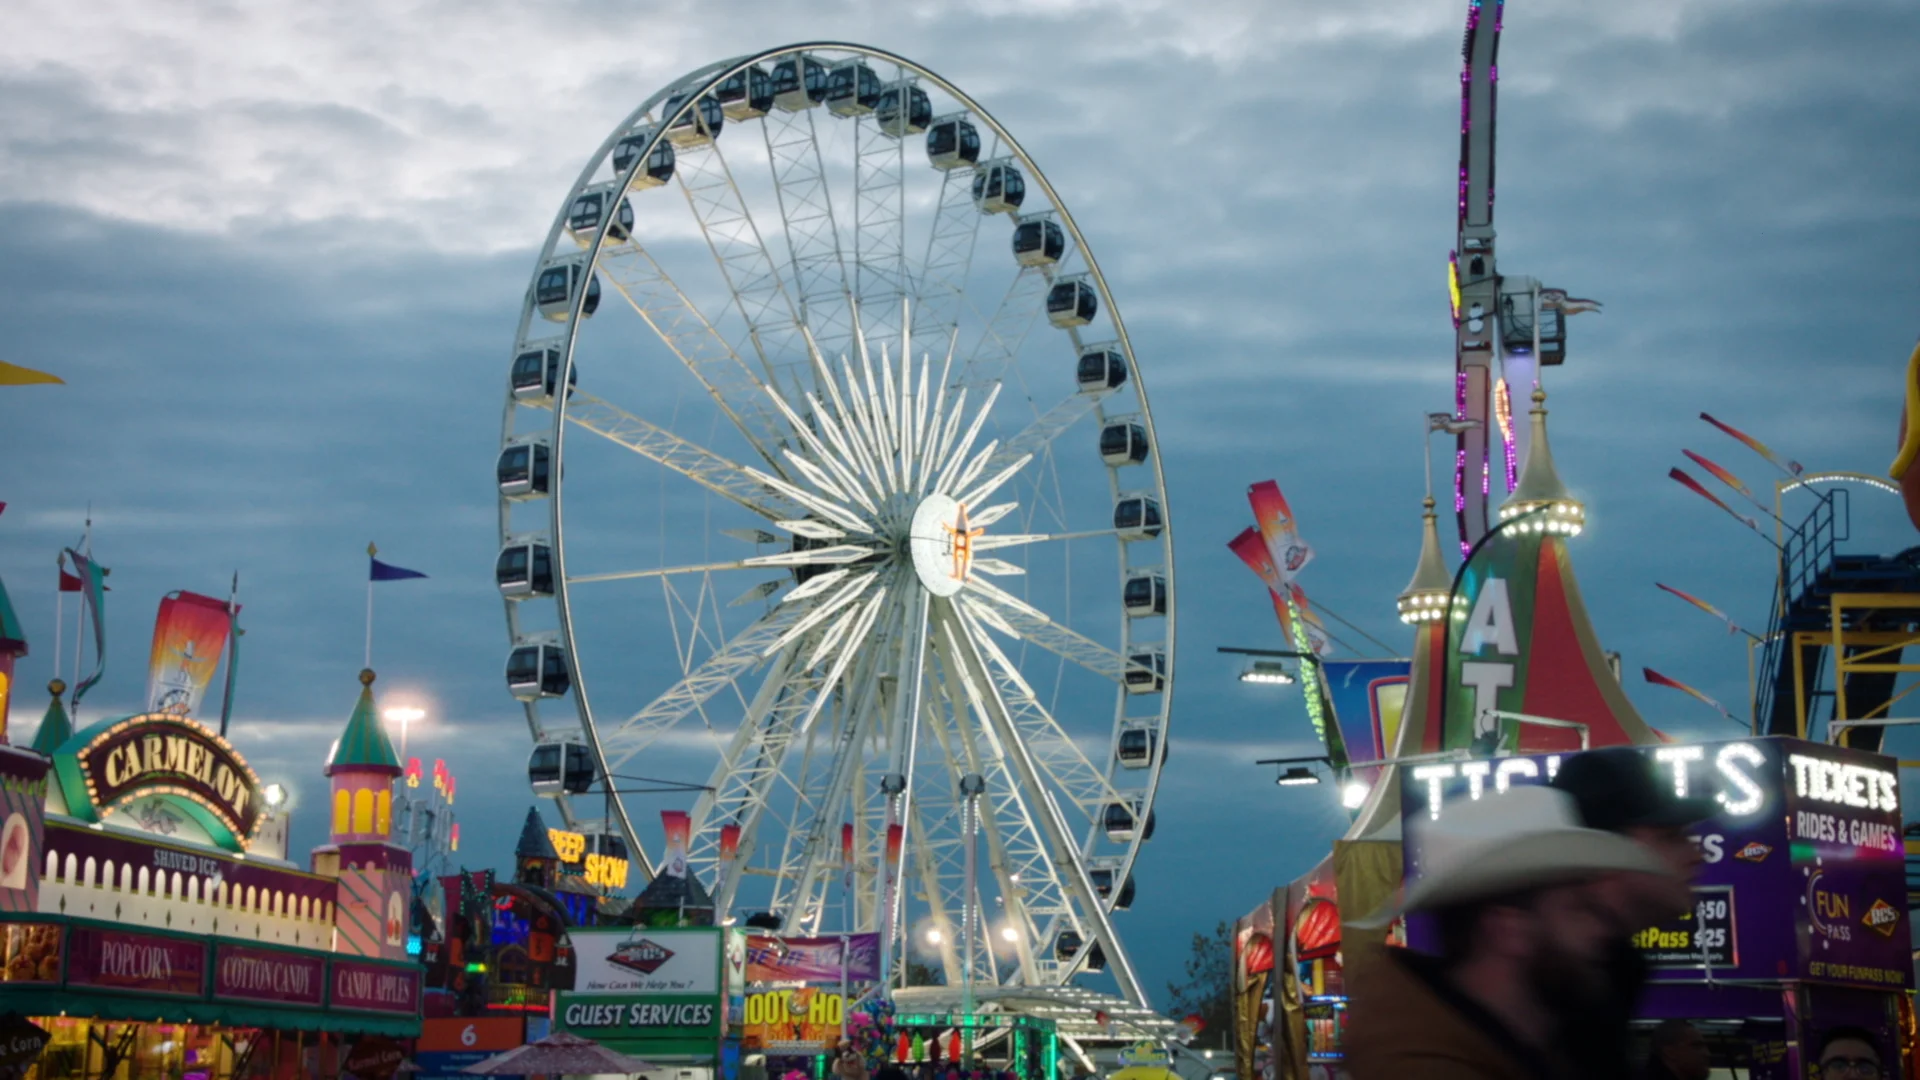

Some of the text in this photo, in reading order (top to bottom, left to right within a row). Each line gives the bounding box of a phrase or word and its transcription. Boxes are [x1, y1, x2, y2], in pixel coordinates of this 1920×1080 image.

[1459, 577, 1519, 750] AT
[105, 735, 250, 819] CARMELOT
[1789, 753, 1897, 812] TICKETS
[1797, 811, 1896, 851] RIDES & GAMES
[154, 849, 218, 876] SHAVED ICE
[584, 853, 629, 889] SHOW
[1696, 900, 1726, 919] $50
[1816, 890, 1849, 919] FUN
[1871, 907, 1896, 925] RCS
[1631, 927, 1726, 948] stPass $25
[1827, 924, 1851, 941] PASS
[101, 940, 173, 979] POPCORN
[1809, 961, 1826, 976] GET
[1826, 963, 1847, 978] YOUR
[1849, 965, 1883, 982] FUNPASS
[223, 956, 312, 995] COTTON CANDY
[338, 970, 410, 1003] CANDY APPLES
[586, 981, 607, 990] How
[609, 981, 628, 989] Can
[630, 981, 643, 989] We
[645, 980, 667, 990] Help
[670, 981, 685, 989] You
[565, 1002, 713, 1026] GUEST SERVICES
[744, 990, 793, 1024] OOT
[10, 1036, 41, 1053] Corn
[461, 1024, 477, 1046] 6
